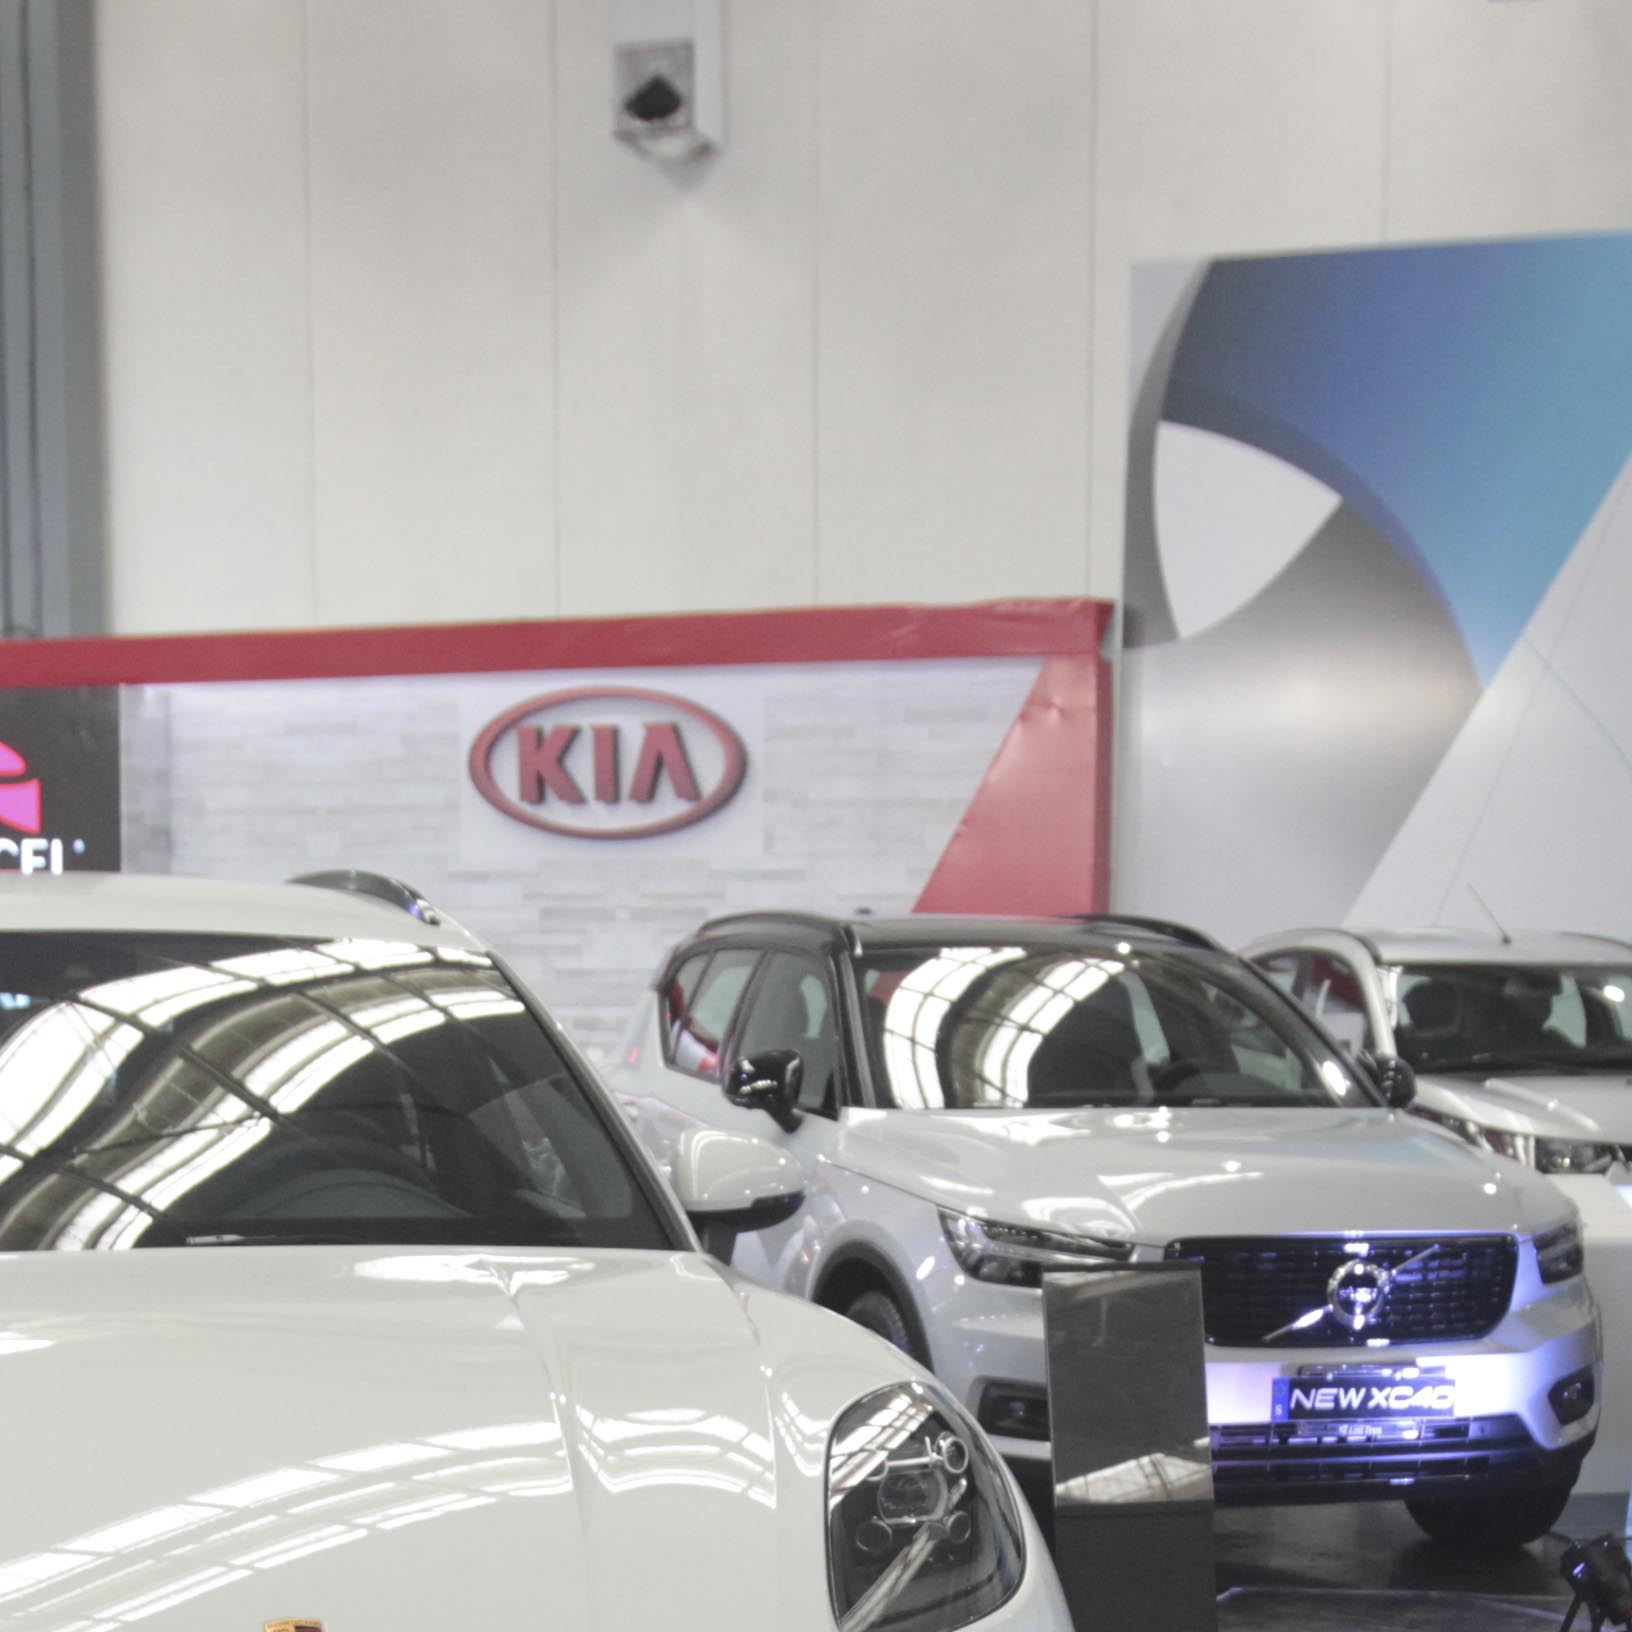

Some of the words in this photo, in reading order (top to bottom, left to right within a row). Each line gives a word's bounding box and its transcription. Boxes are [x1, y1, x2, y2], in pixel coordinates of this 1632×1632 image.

[517, 722, 702, 805] KIA
[1290, 1387, 1366, 1410] NEW
[1368, 1385, 1456, 1410] XC40
